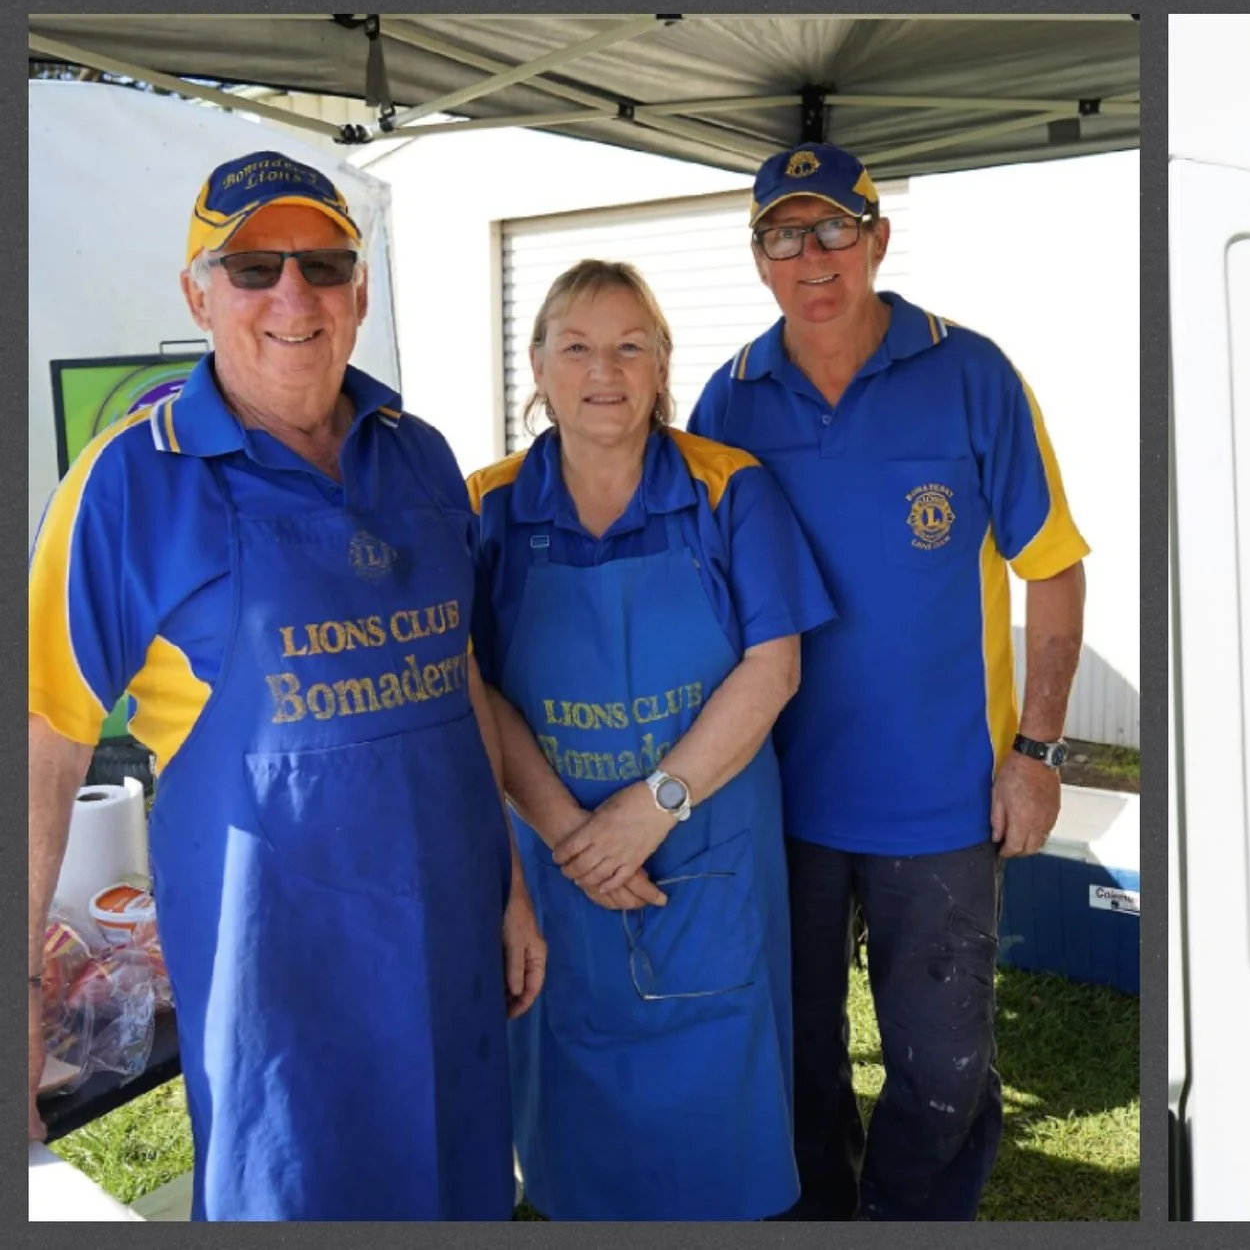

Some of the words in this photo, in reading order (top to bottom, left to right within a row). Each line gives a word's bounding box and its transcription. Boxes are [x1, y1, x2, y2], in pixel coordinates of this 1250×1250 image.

[244, 170, 302, 190] Lions
[280, 615, 387, 658] LIONS
[390, 599, 461, 644] CLUB
[542, 699, 630, 731] LIONS
[632, 681, 703, 724] CLUB
